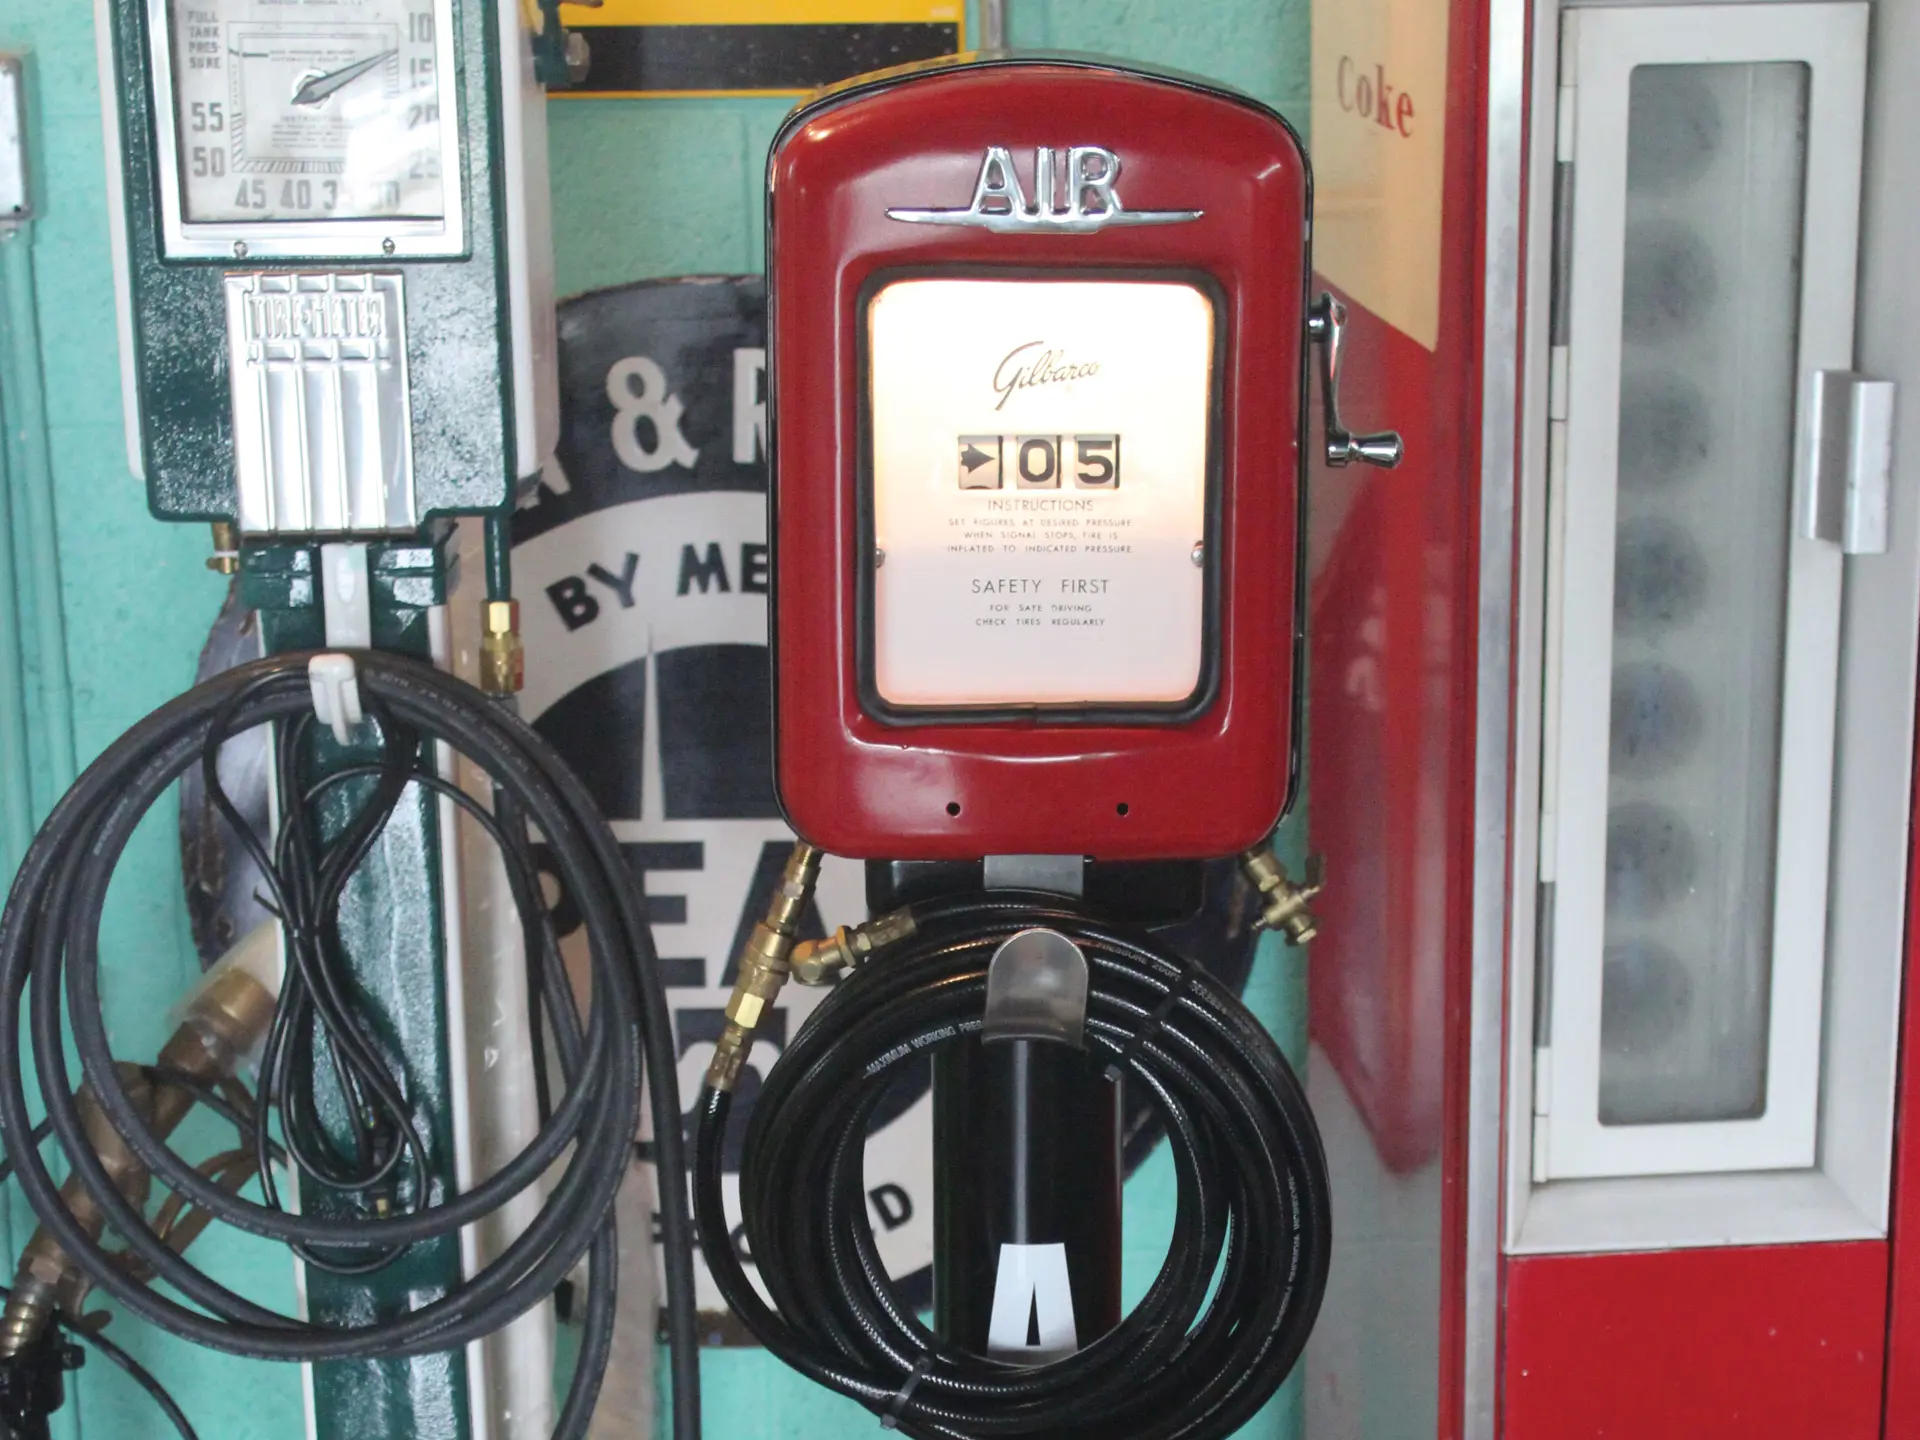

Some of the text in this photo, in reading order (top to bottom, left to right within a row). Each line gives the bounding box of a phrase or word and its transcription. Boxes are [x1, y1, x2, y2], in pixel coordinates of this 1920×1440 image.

[189, 27, 220, 38] TANK
[409, 12, 432, 42] 10
[409, 58, 433, 88] 15
[1337, 55, 1414, 139] Coke
[191, 102, 224, 132] 55
[193, 147, 225, 177] 50
[234, 180, 266, 209] 45
[280, 180, 311, 209] 40
[970, 145, 1124, 222] AIR
[993, 340, 1100, 412] Gilbarco
[988, 500, 1094, 511] INSTRUCTIONS
[964, 531, 993, 540] WHEN
[1001, 531, 1036, 540] SIGNAL
[1083, 531, 1101, 540] TIRE
[1110, 531, 1119, 540] IS
[974, 518, 1015, 527] FIGURES
[1022, 518, 1034, 527] AT
[1040, 518, 1079, 527] DESIRED
[1086, 518, 1132, 527] PRESSURE
[948, 545, 1132, 553] INFLATED TO INDICATED PRESSURE
[544, 552, 640, 632] BY
[971, 579, 1109, 594] SAFETY FIRST
[975, 618, 1106, 626] CHECK TIRES REGULARLY
[989, 604, 1092, 613] FOR SAFE DRIVING
[865, 1043, 912, 1075] MAXIMUM
[910, 1026, 957, 1049] WORKING
